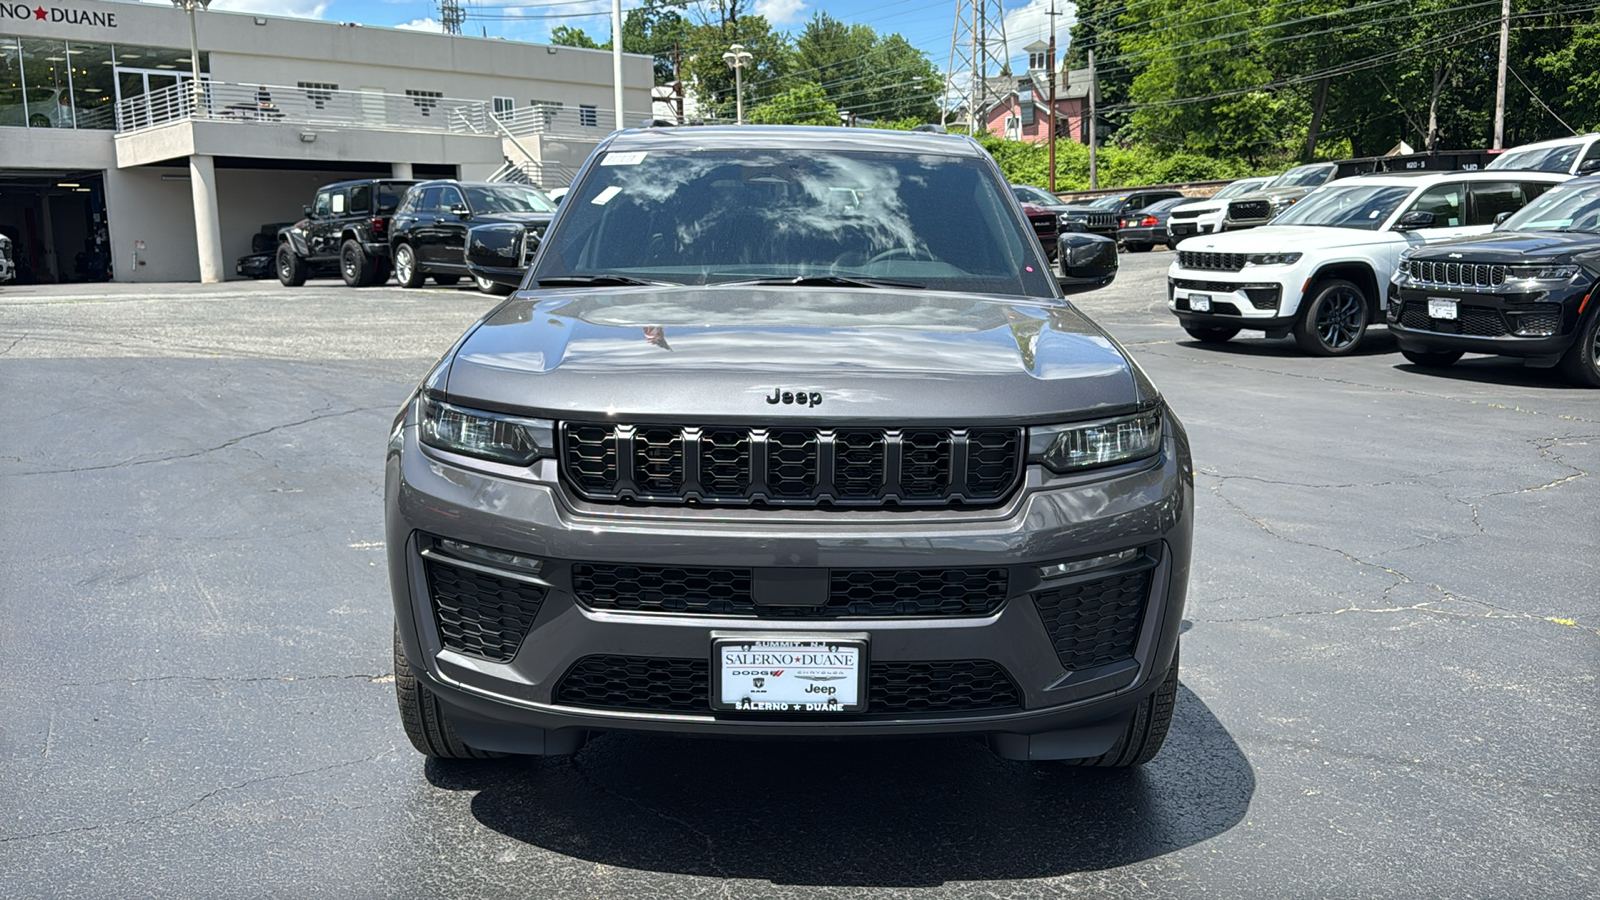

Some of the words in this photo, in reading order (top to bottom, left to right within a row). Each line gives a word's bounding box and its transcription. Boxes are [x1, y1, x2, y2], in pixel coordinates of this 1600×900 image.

[0, 3, 31, 20] NO
[50, 8, 118, 28] DUANE
[766, 387, 823, 408] Jeep
[726, 654, 793, 666] SALERNO
[802, 655, 854, 666] DUANE
[805, 683, 836, 695] Jeep
[735, 701, 789, 711] SALERNO
[806, 703, 844, 712] DUANE
